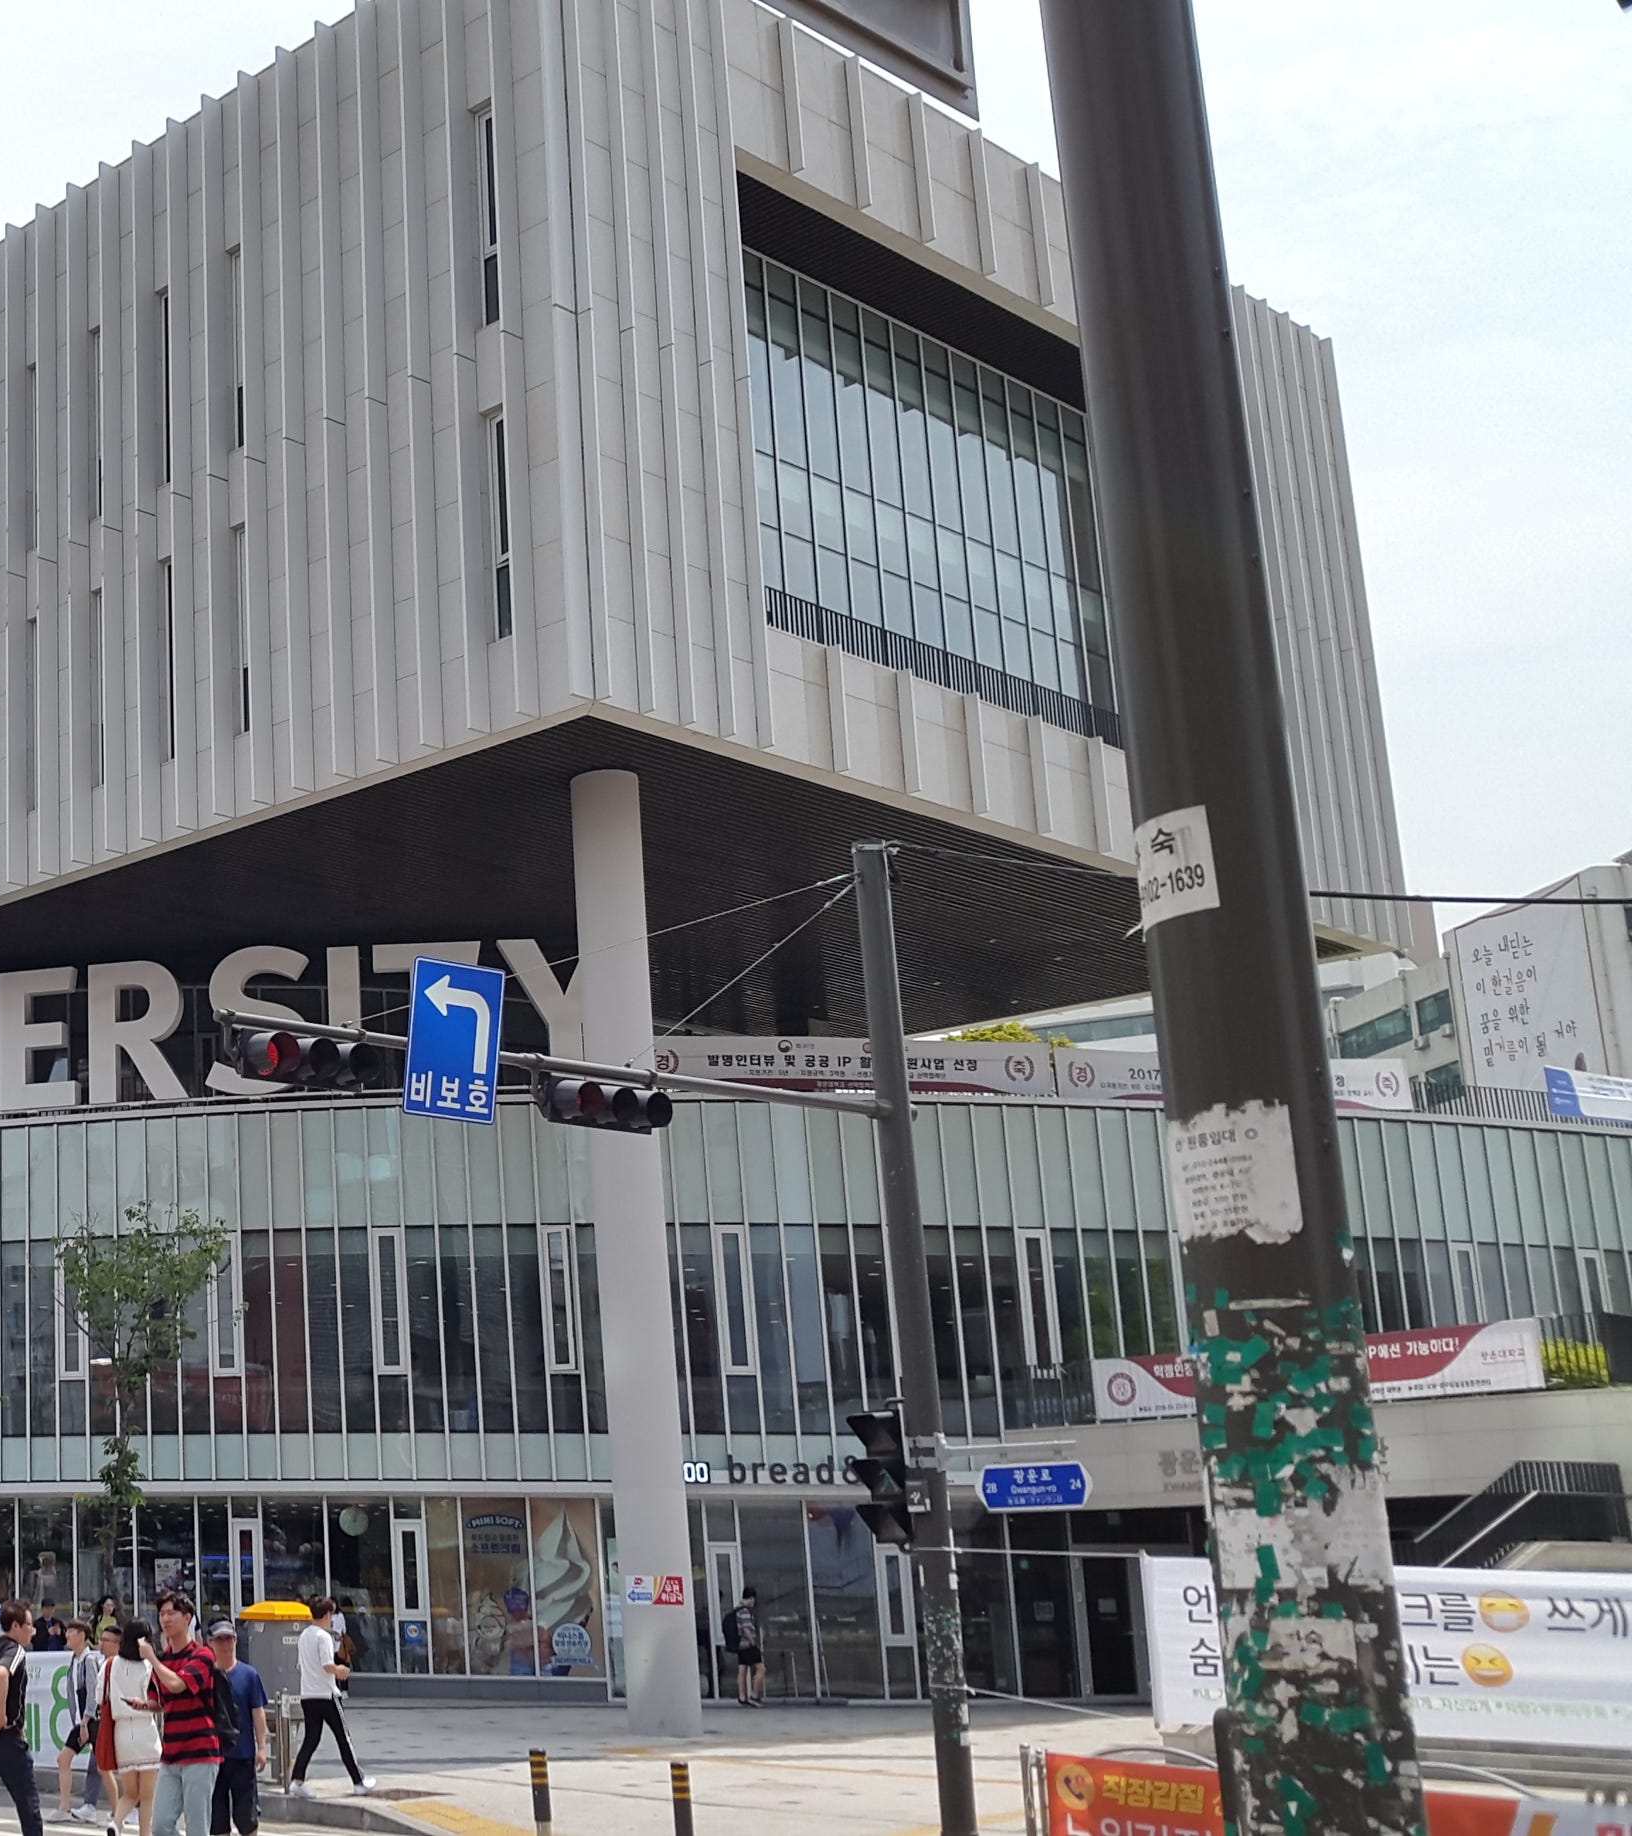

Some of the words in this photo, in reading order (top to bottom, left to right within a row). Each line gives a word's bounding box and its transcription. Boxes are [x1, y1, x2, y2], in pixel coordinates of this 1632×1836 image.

[1472, 945, 1493, 966] 오늘
[1475, 978, 1486, 995] 이
[1491, 965, 1537, 996] 한걸음이
[1480, 1008, 1502, 1035] 꿈을
[1508, 998, 1531, 1025] 위한
[1554, 1020, 1577, 1040] 거야
[707, 1054, 776, 1068] 발명인터뷰
[784, 1055, 796, 1068] 및
[804, 1055, 830, 1068] 공공
[837, 1056, 852, 1068] IP
[953, 1059, 978, 1072] 선정
[1075, 1067, 1088, 1083] 경
[1129, 1068, 1161, 1081] 2017
[410, 1070, 489, 1115] 비보호
[1406, 1336, 1460, 1357] 가능하다!
[1012, 1468, 1053, 1484] 광운로
[1069, 1478, 1082, 1490] 24
[985, 1482, 998, 1494] 28
[1010, 1484, 1058, 1496] Gwangun-ro
[1102, 1774, 1205, 1815] 직장갑질
